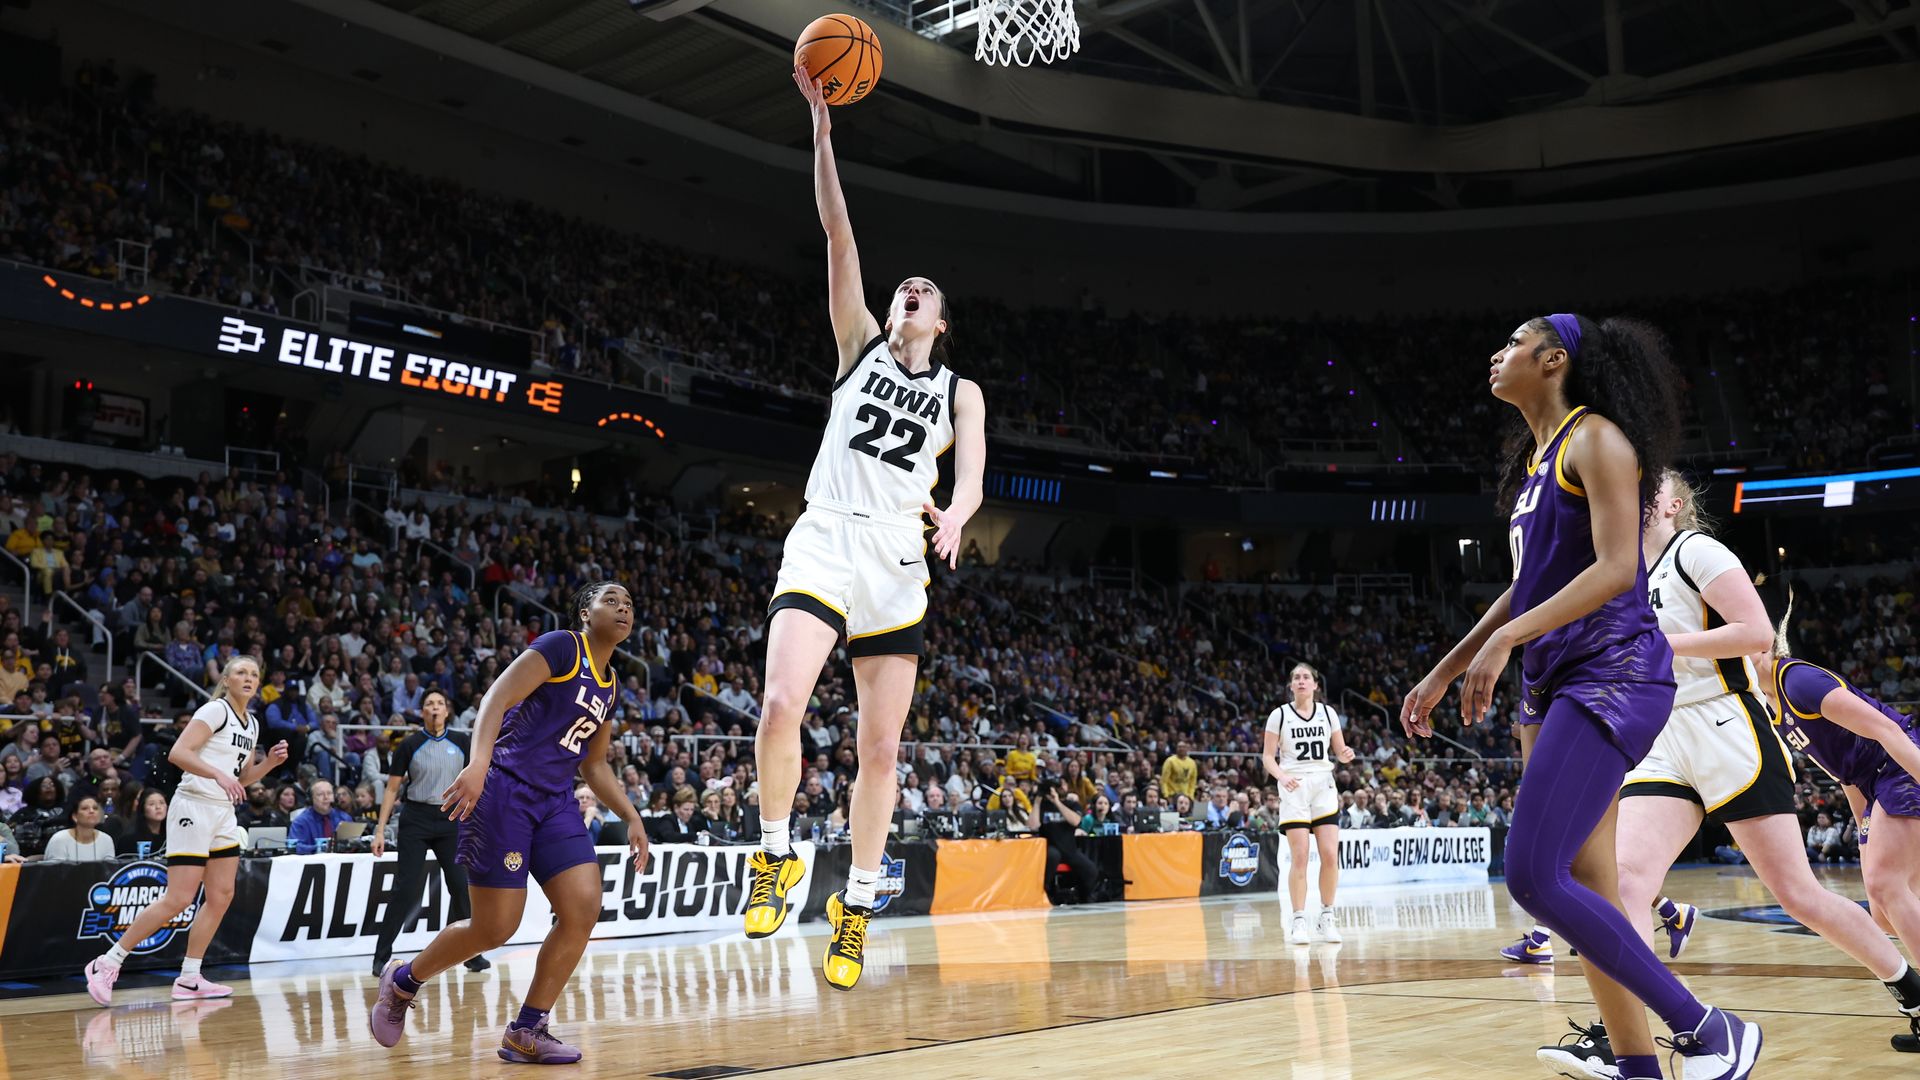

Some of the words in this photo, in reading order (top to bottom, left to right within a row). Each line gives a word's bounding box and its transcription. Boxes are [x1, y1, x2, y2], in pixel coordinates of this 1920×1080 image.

[278, 328, 395, 382] ELITE
[400, 353, 517, 402] EIGHT
[860, 370, 942, 426] IOWA
[848, 402, 927, 473] 22
[1510, 485, 1541, 523] SU
[574, 685, 608, 725] LSU
[559, 716, 597, 755] 12
[1291, 726, 1325, 739] IOWA
[1295, 740, 1324, 761] 20
[1786, 726, 1811, 751] SU
[233, 752, 247, 777] 3
[1372, 845, 1390, 863] AND
[1392, 837, 1429, 866] SIENA
[1431, 836, 1486, 865] COLLEGE
[280, 859, 448, 942] ALBA
[552, 850, 794, 926] EGION
